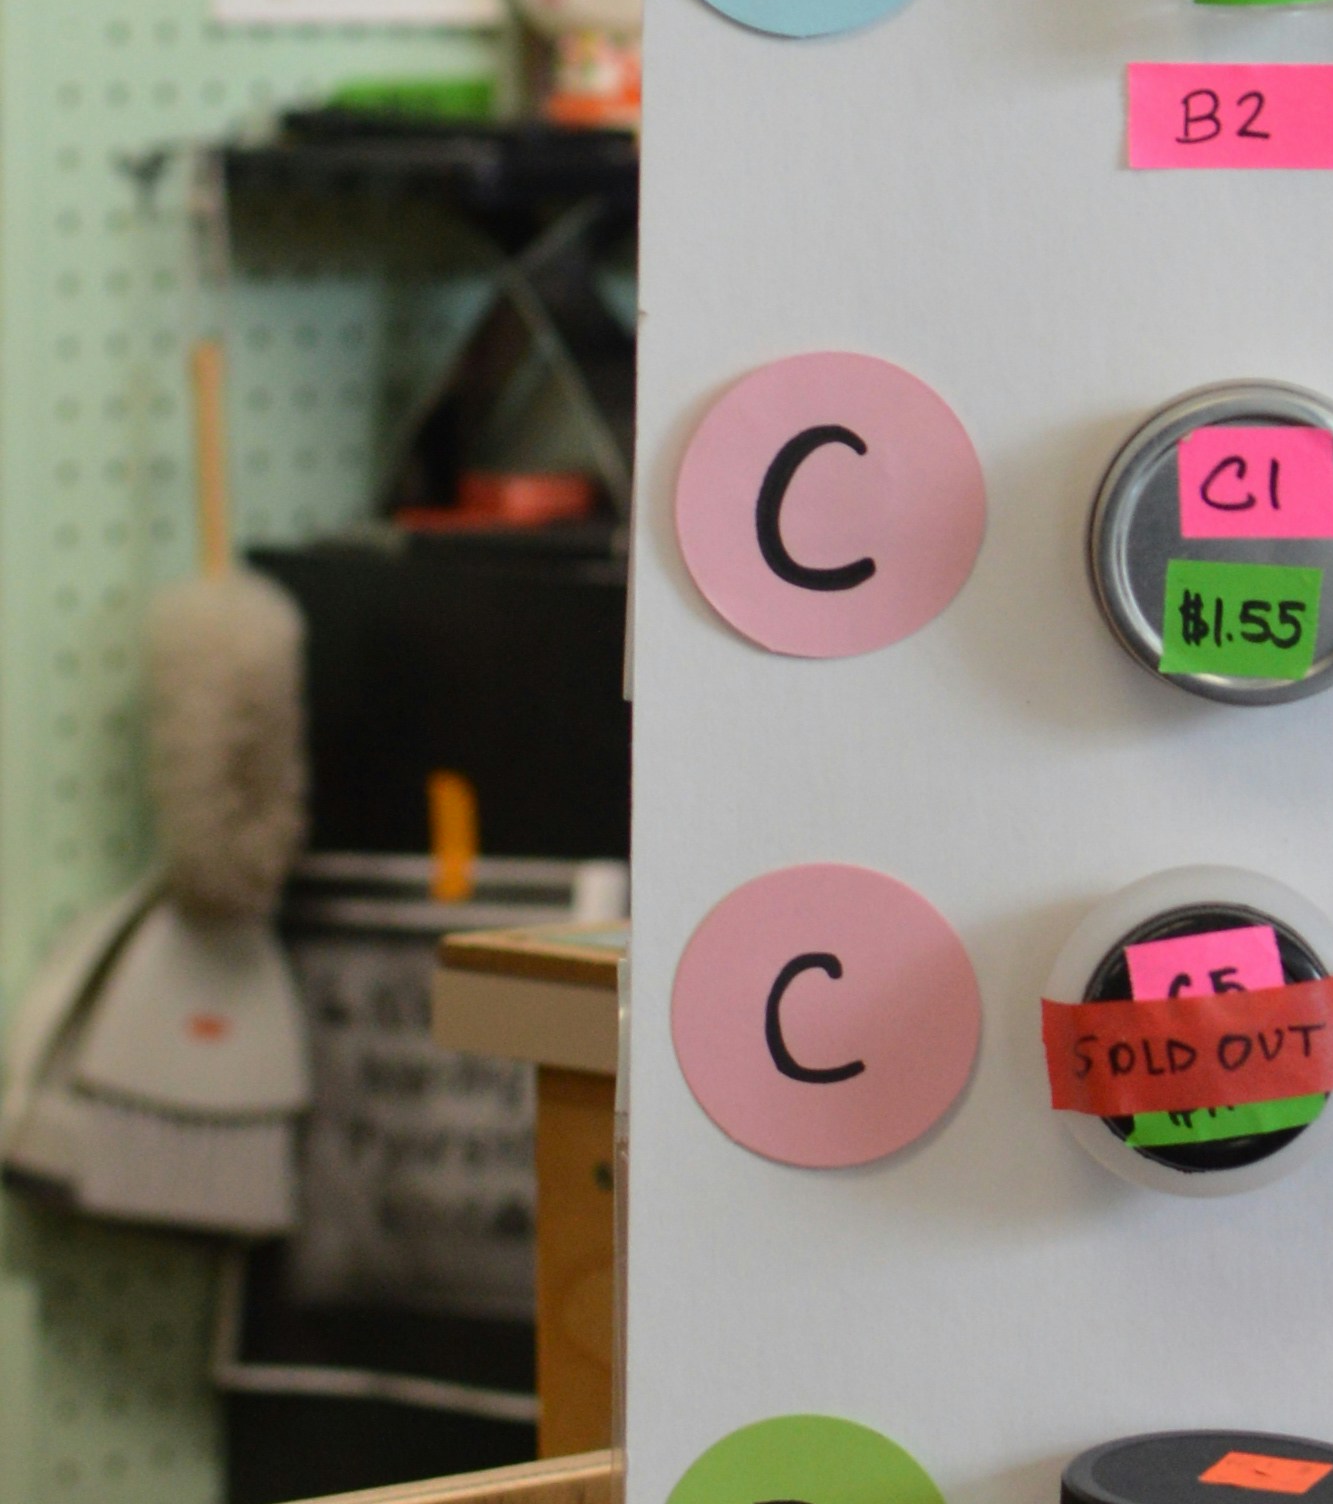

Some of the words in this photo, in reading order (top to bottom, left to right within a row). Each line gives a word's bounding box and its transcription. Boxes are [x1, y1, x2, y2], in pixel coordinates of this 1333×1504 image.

[1174, 89, 1272, 146] B2
[755, 422, 876, 592] C
[1199, 454, 1283, 512] C1
[1180, 588, 1308, 650] $1.55
[765, 952, 866, 1084] C
[1072, 1035, 1197, 1080] SOLD
[1216, 1022, 1327, 1072] OUT
